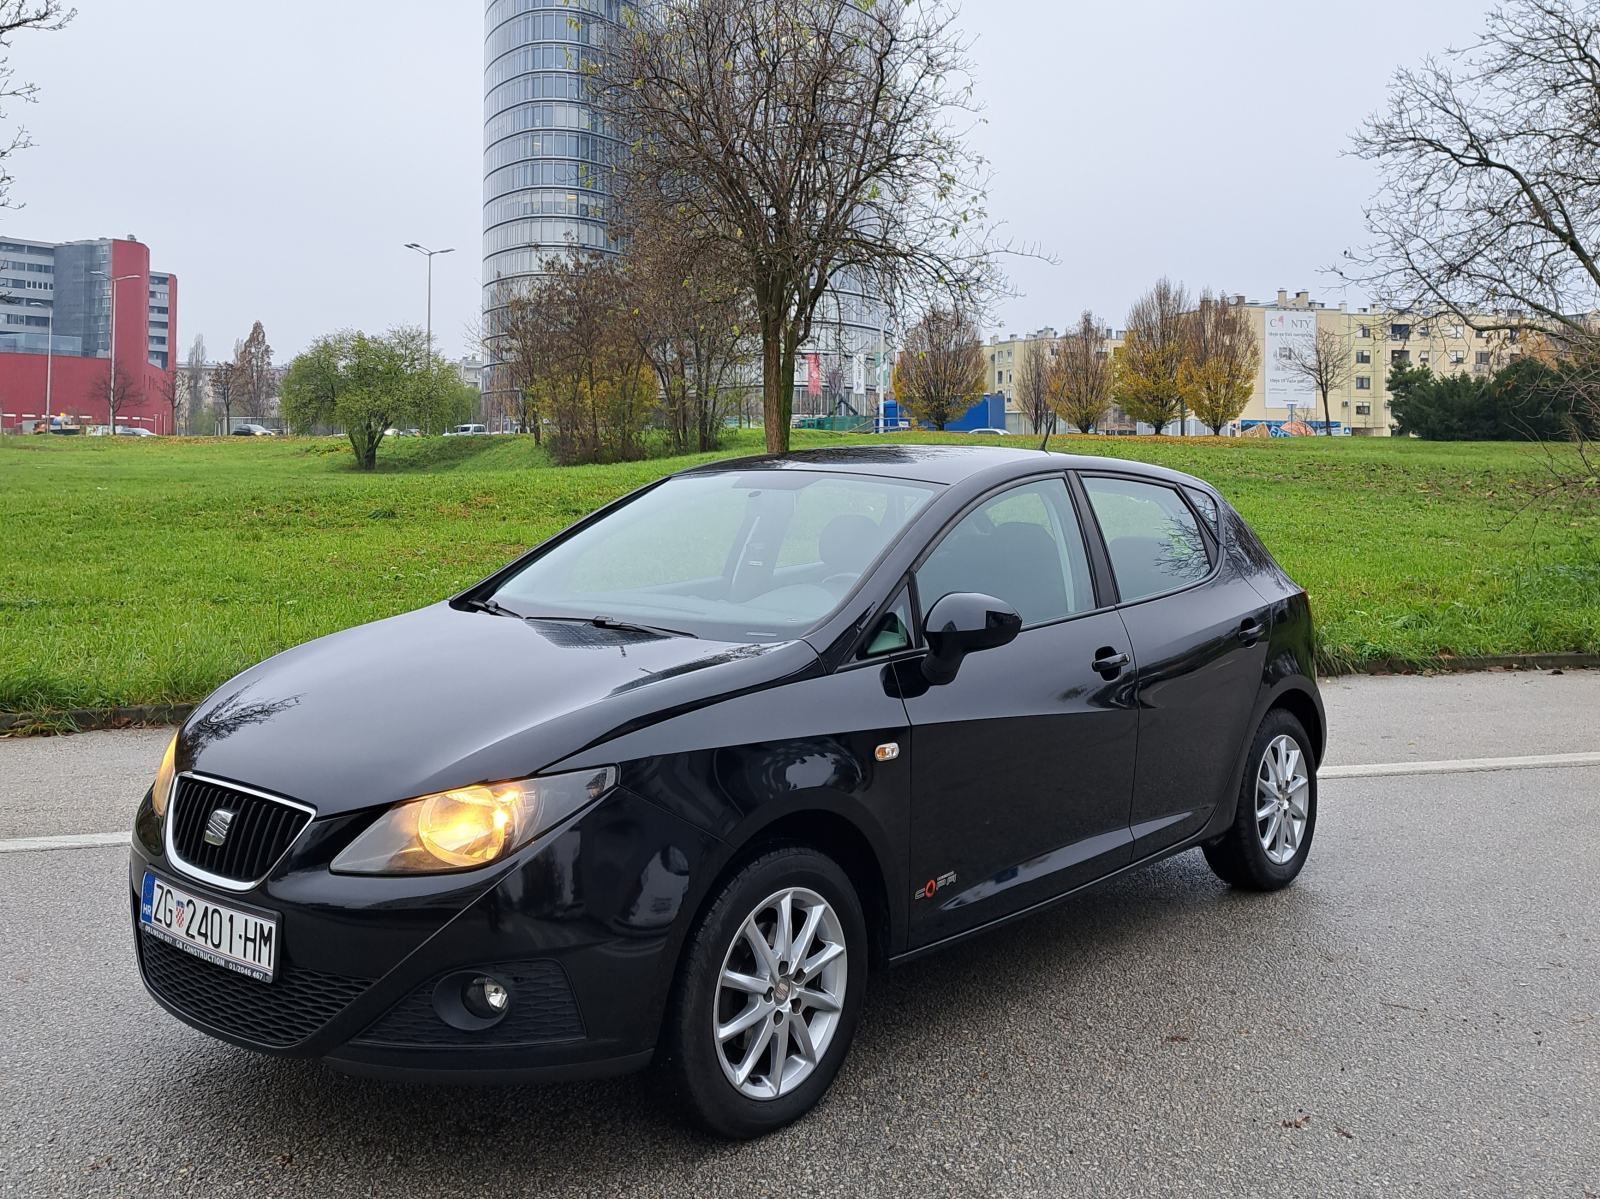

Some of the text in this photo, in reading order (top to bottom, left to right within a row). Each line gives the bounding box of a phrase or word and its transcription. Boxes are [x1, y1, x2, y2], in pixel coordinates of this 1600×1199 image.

[143, 904, 152, 916] HR
[153, 883, 174, 928] ZG
[184, 943, 225, 967] CONSTRUCTION
